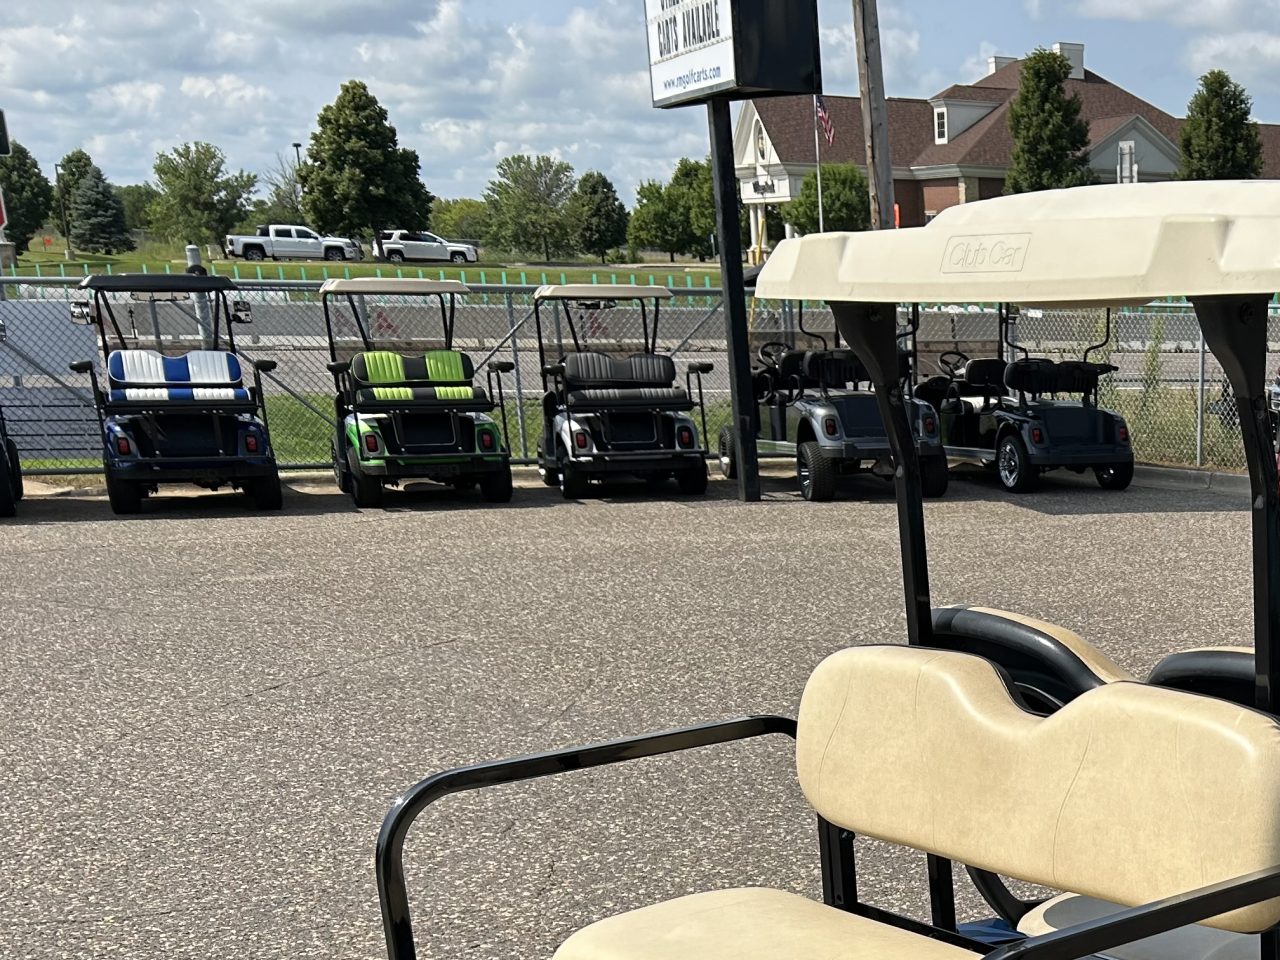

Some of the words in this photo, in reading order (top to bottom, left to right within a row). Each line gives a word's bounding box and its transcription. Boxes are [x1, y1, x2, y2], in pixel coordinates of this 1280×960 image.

[657, 15, 679, 58] CARTS
[682, 0, 720, 49] AVAILABLE
[950, 242, 987, 268] Club
[988, 241, 1022, 266] Car
